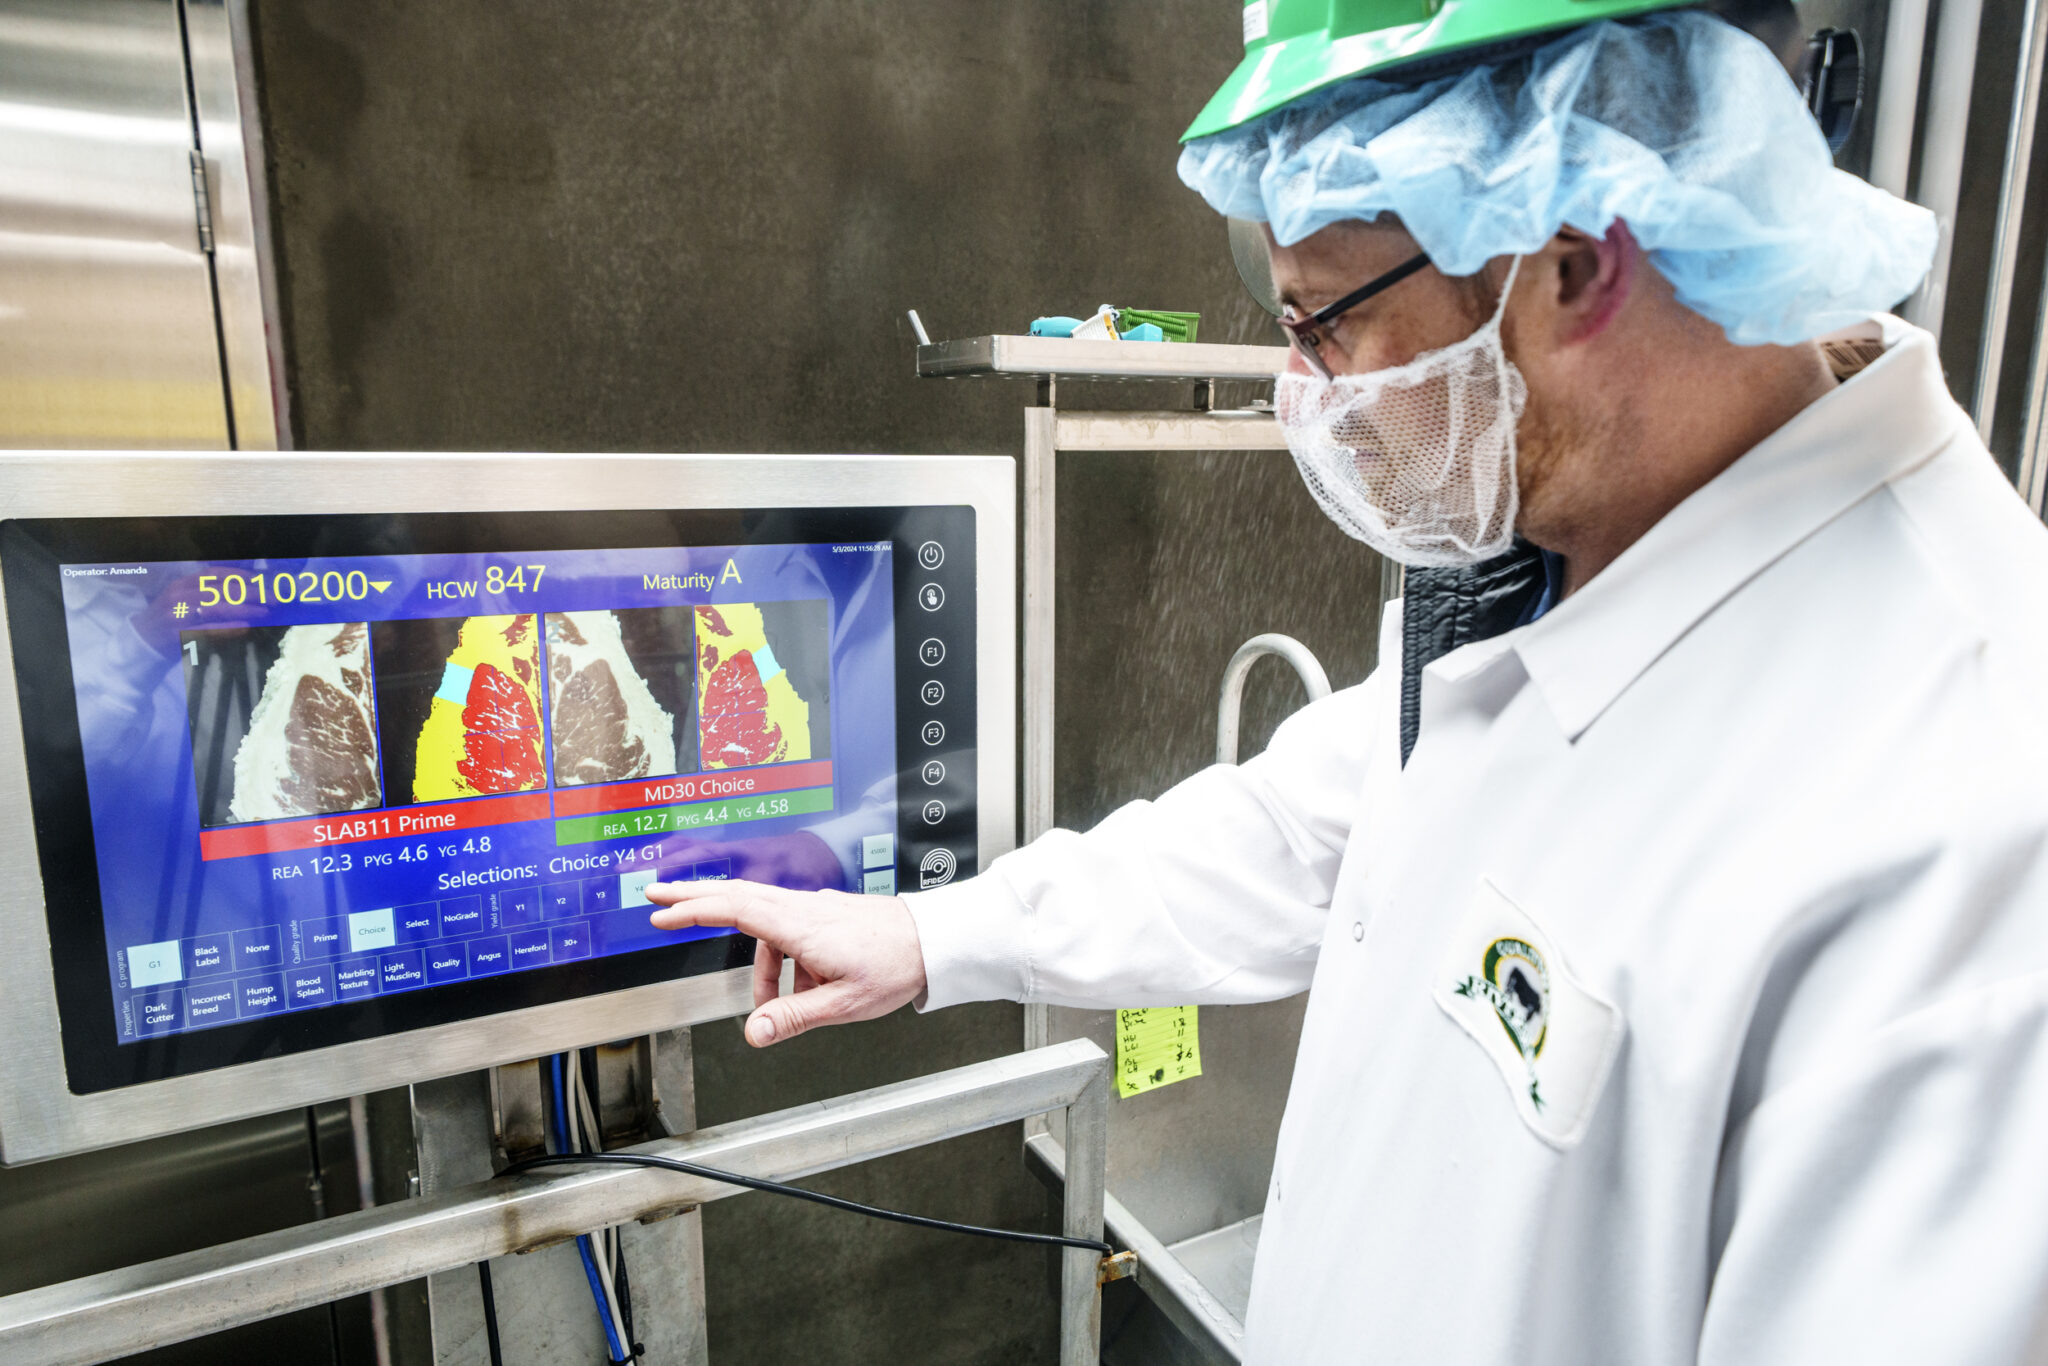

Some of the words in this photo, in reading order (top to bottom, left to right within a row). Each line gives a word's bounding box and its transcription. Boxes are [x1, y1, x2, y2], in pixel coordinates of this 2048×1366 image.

[63, 568, 108, 578] Operator:
[109, 566, 148, 575] Amanda
[643, 572, 715, 592] Maturity
[720, 558, 743, 584] A
[427, 581, 478, 599] HCW
[485, 565, 546, 594] 847
[173, 602, 189, 619] #
[199, 570, 368, 607] 5010200
[183, 640, 199, 666] 1
[927, 647, 938, 657] F1
[927, 687, 939, 698] F2
[928, 728, 940, 738] F3
[928, 768, 940, 778] F4
[644, 782, 695, 802] MD30
[700, 777, 755, 797] Choice
[603, 824, 628, 836] REA
[633, 813, 668, 833] 12.7
[676, 814, 700, 827] PYG
[704, 806, 729, 823] 4.4
[736, 807, 751, 819] YG
[755, 798, 789, 816] 4.58
[928, 807, 940, 817] F5
[313, 818, 390, 843] SLAB11
[399, 812, 456, 832] Prime
[272, 867, 303, 880] REA
[310, 854, 352, 875] 12.3
[364, 853, 393, 868] PYG
[398, 844, 428, 863] 4.6
[438, 844, 457, 858] YG
[462, 836, 491, 855] 4.8
[438, 863, 538, 891] Selections:
[549, 852, 610, 874] Choice
[614, 848, 636, 864] Y4
[641, 844, 663, 860] G1
[922, 878, 937, 886] RFID
[489, 894, 499, 911] grade
[444, 911, 478, 922] NoGrade
[490, 912, 498, 929] Yield
[290, 920, 301, 938] grade
[405, 919, 430, 929] Select
[358, 925, 386, 936] Choice
[313, 932, 338, 943] Prime
[564, 939, 578, 947] 30+
[194, 945, 219, 956] Black
[245, 943, 270, 954] None
[293, 940, 302, 965] Quality
[514, 943, 547, 955] Hereford
[195, 956, 220, 967] Label
[477, 951, 501, 962] Angus
[117, 950, 127, 978] program
[384, 963, 405, 973] Light
[433, 959, 460, 970] Quality
[338, 967, 375, 980] Marbling
[385, 971, 421, 982] Muscling
[119, 980, 127, 988] G
[296, 976, 321, 987] Blood
[339, 979, 369, 991] Texture
[246, 985, 274, 998] Hump
[297, 986, 325, 999] Splash
[191, 992, 231, 1005] Incorrect
[248, 995, 277, 1007] Height
[145, 1003, 167, 1014] Dark
[193, 1005, 219, 1016] Breed
[124, 1000, 133, 1036] Properties
[146, 1013, 175, 1025] Cutter
